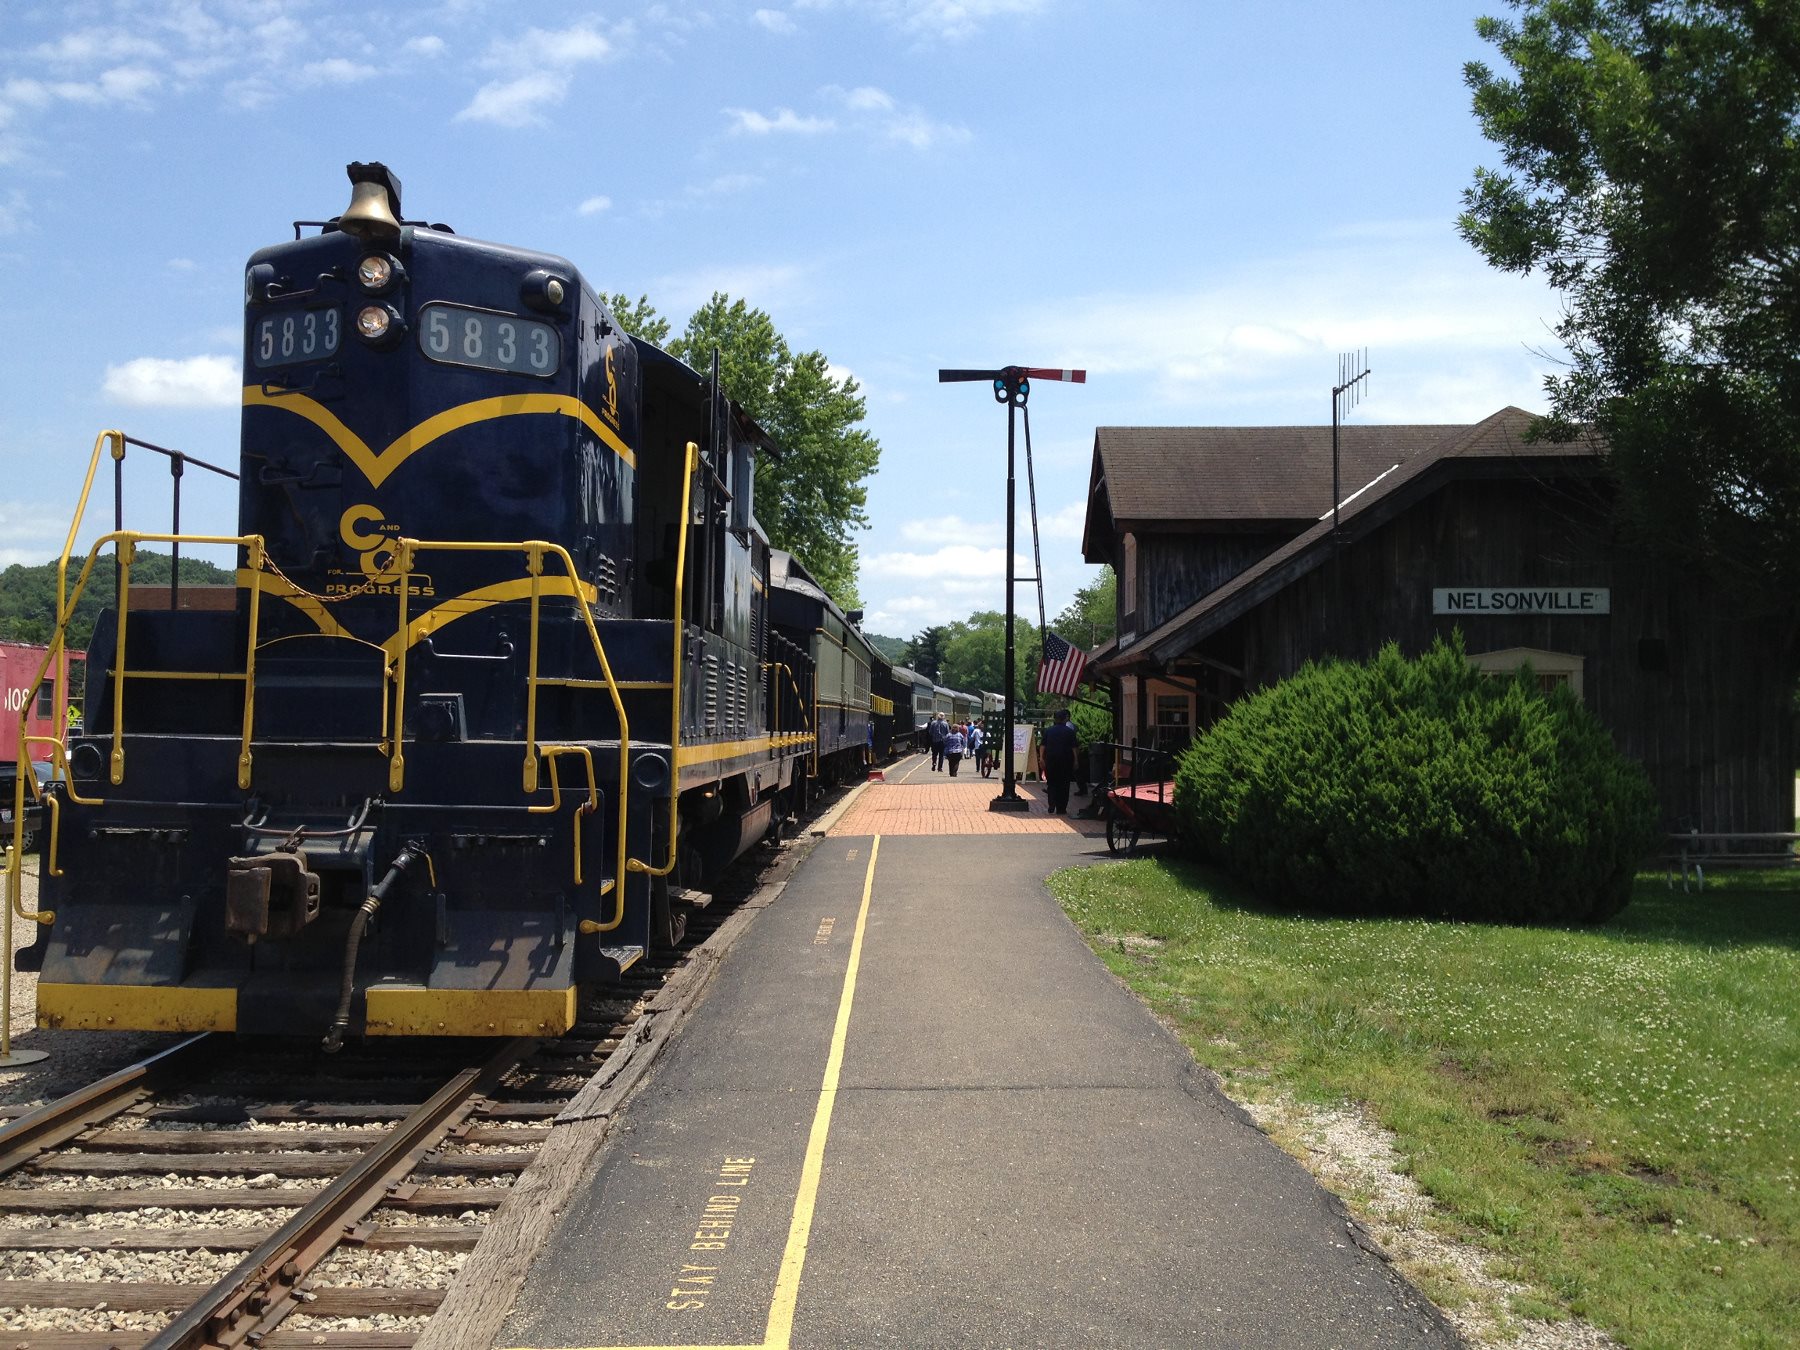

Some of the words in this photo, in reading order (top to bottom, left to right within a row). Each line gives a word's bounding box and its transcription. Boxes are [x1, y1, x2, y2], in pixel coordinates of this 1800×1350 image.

[261, 308, 338, 360] 5833
[429, 311, 549, 369] 5833
[326, 584, 435, 596] PROGRESS
[1447, 592, 1594, 610] NELSONVILLE
[4, 687, 30, 711] 108
[715, 1156, 756, 1186] LINE
[690, 1195, 741, 1250] BEHIND
[666, 1264, 718, 1310] STAY
